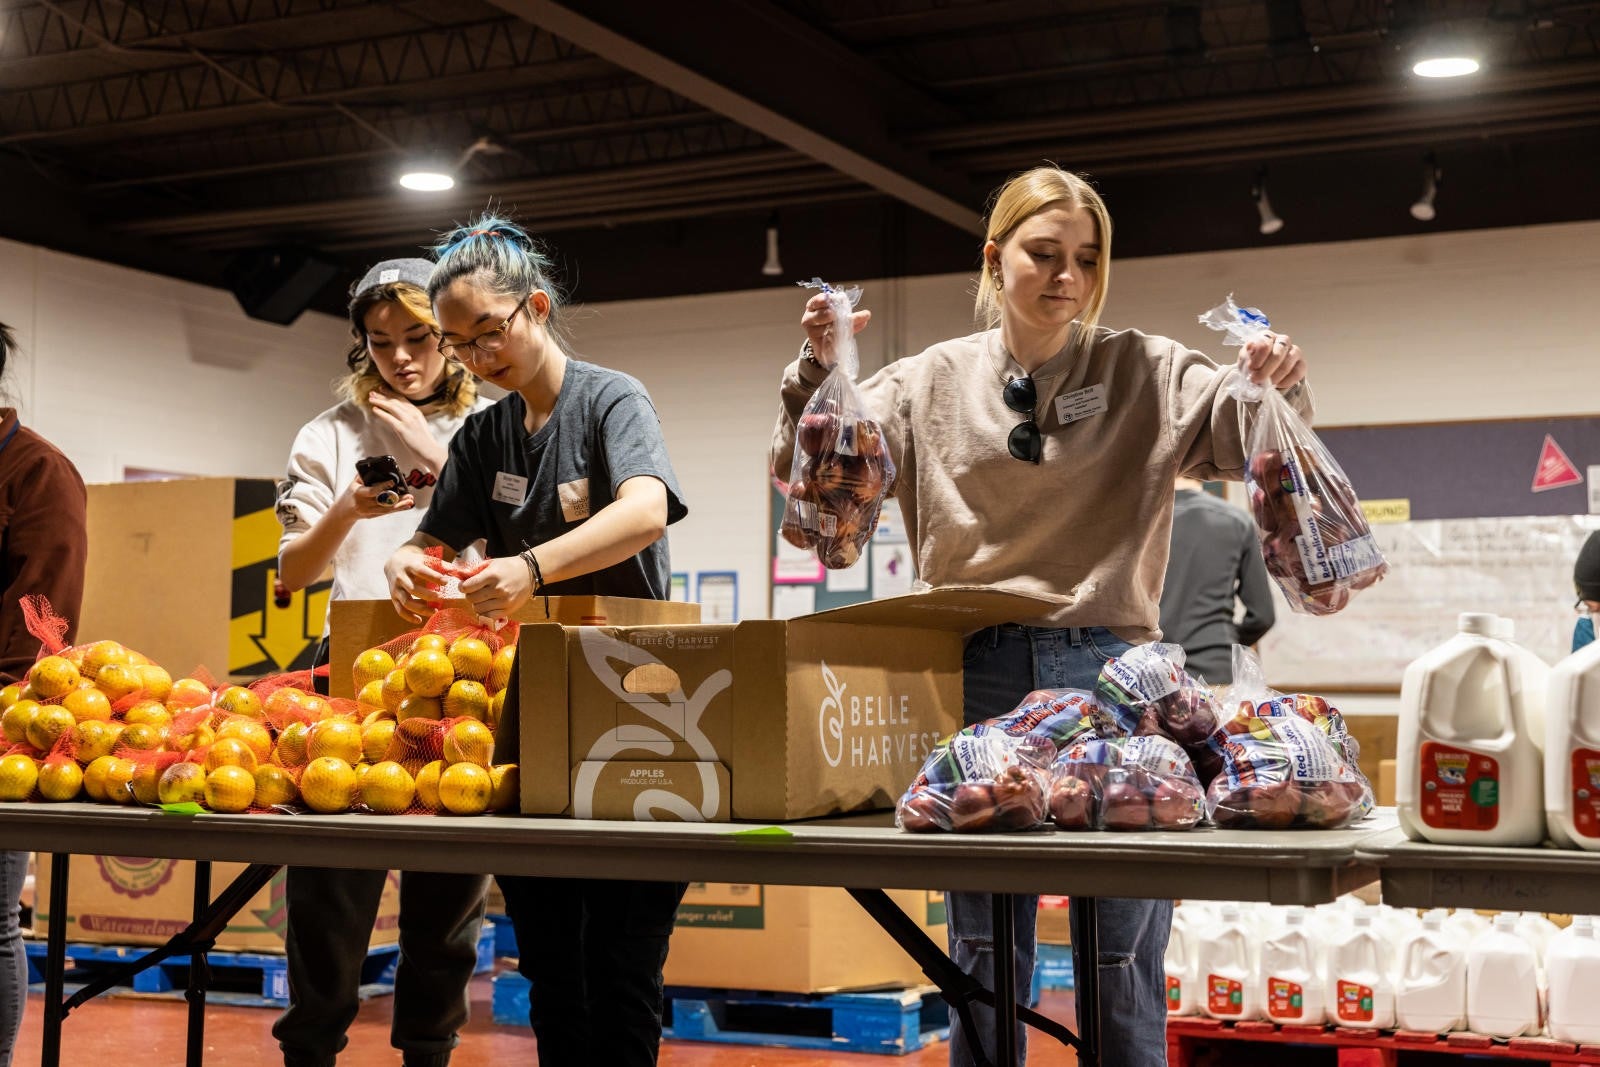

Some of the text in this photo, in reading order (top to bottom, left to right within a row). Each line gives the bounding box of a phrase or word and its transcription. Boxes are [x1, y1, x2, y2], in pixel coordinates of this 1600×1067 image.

[1307, 517, 1331, 578] Red Delicious
[677, 636, 721, 645] HARVEST
[850, 695, 909, 726] BELLE
[630, 769, 665, 778] APPLES
[1297, 755, 1308, 778] Red
